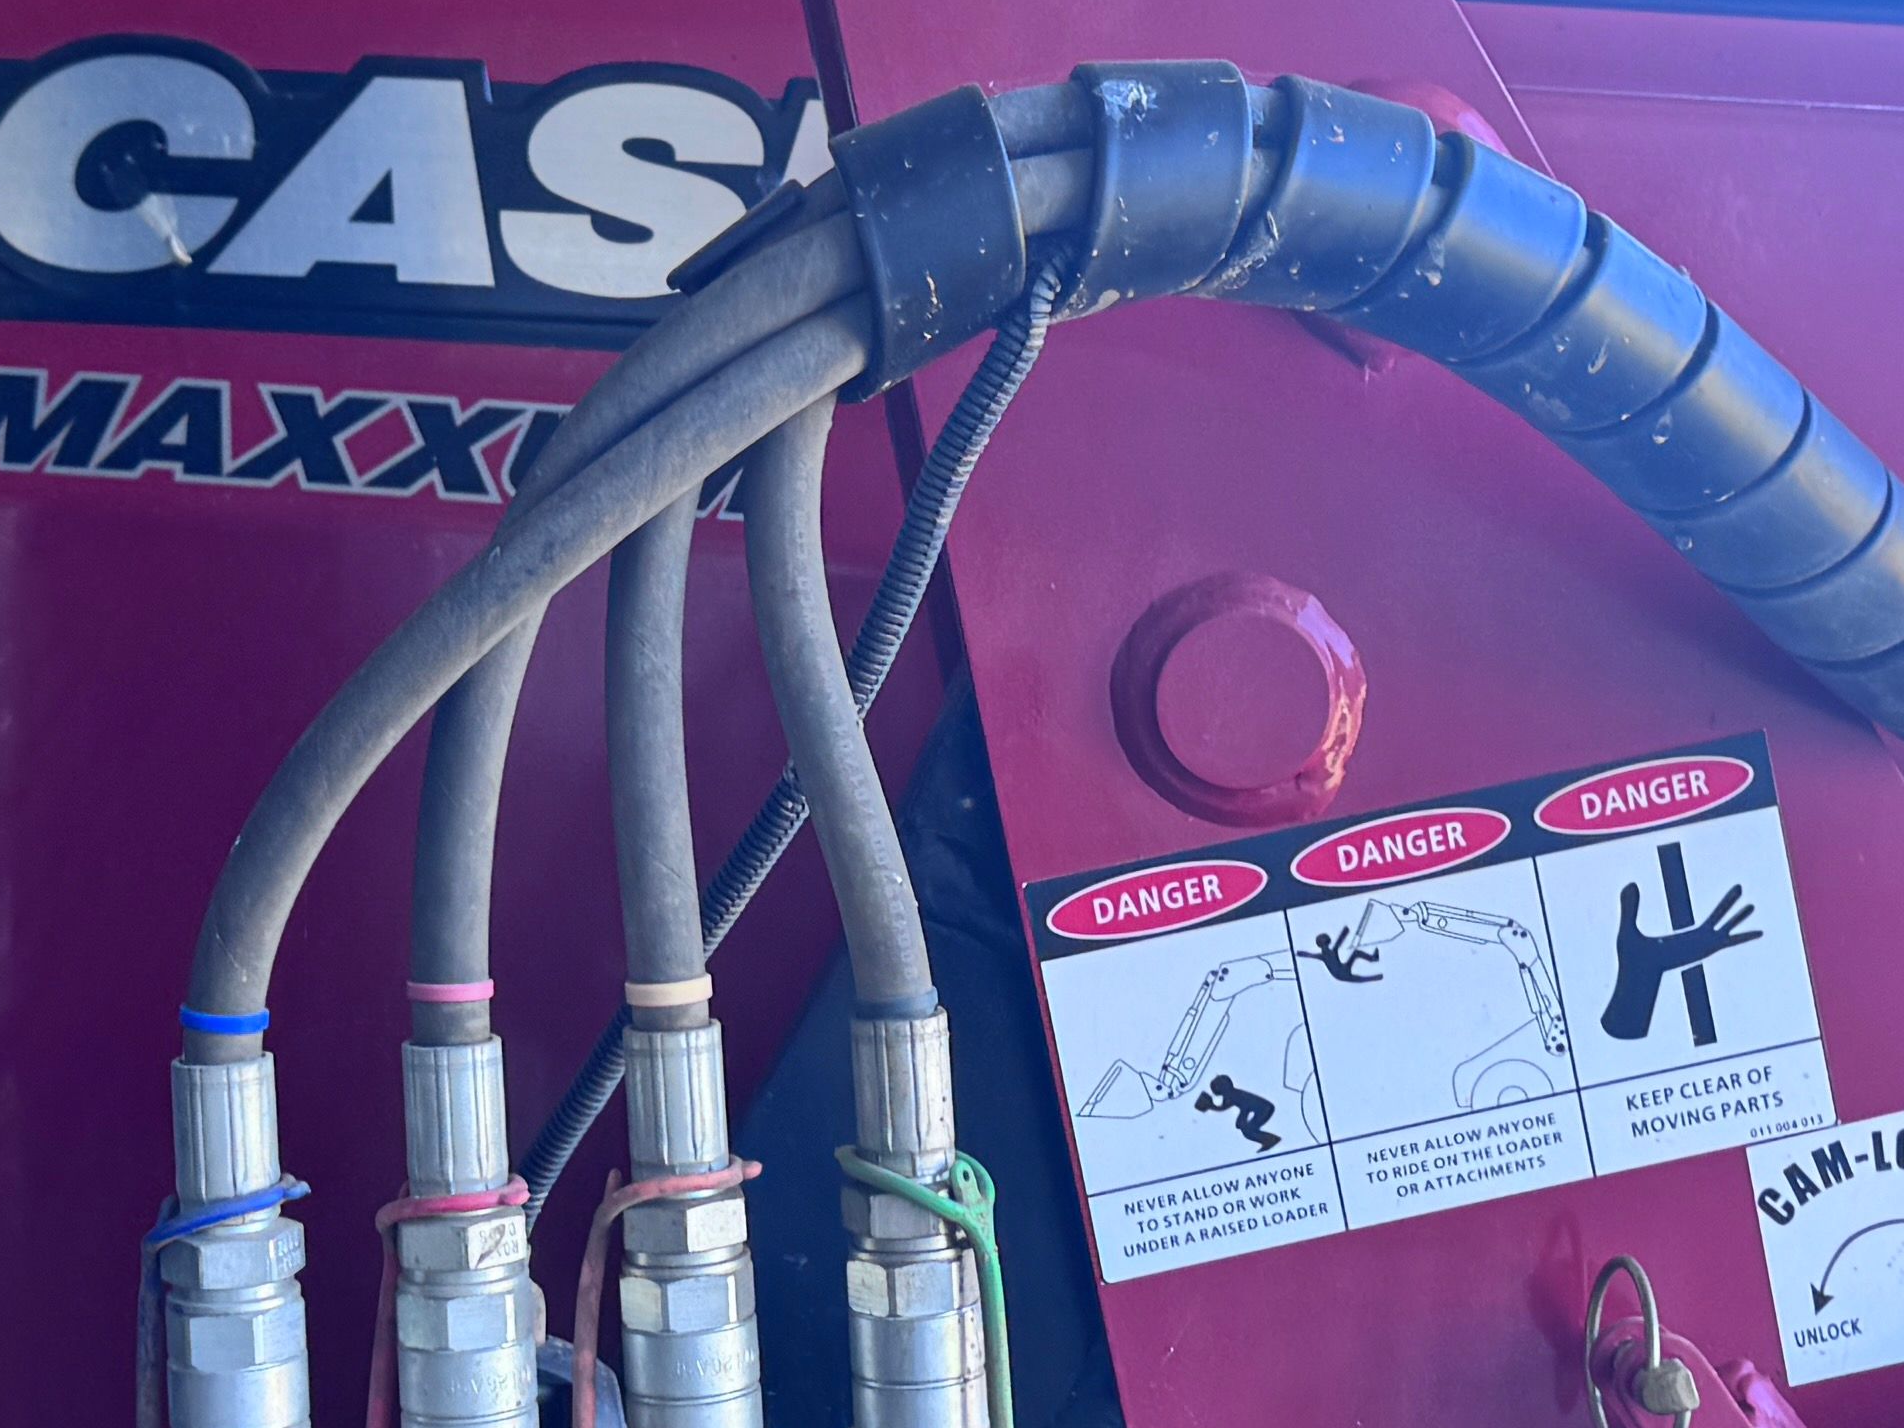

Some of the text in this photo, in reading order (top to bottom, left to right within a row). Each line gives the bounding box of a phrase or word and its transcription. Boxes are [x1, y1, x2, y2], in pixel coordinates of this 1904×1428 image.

[1580, 769, 1711, 822] DANGER
[1337, 821, 1467, 872] DANGER
[1092, 874, 1223, 925] DANGER
[1626, 1065, 1772, 1111] KEEP CLEAR OF
[1367, 1112, 1557, 1164] NEVER ALLOW ANYONE
[1631, 1091, 1784, 1138] MOVING PARTS
[1366, 1131, 1563, 1184] TO RIDE ON THE LOADER
[1396, 1155, 1547, 1199] OR ATTACHMENTS
[1124, 1163, 1315, 1216] NEVER ALLOW ANYONE
[1137, 1187, 1302, 1234] TO STAND OR WORK
[1123, 1202, 1329, 1258] UNDER A RAISED LOADER
[1793, 1318, 1864, 1348] UNLOCK
